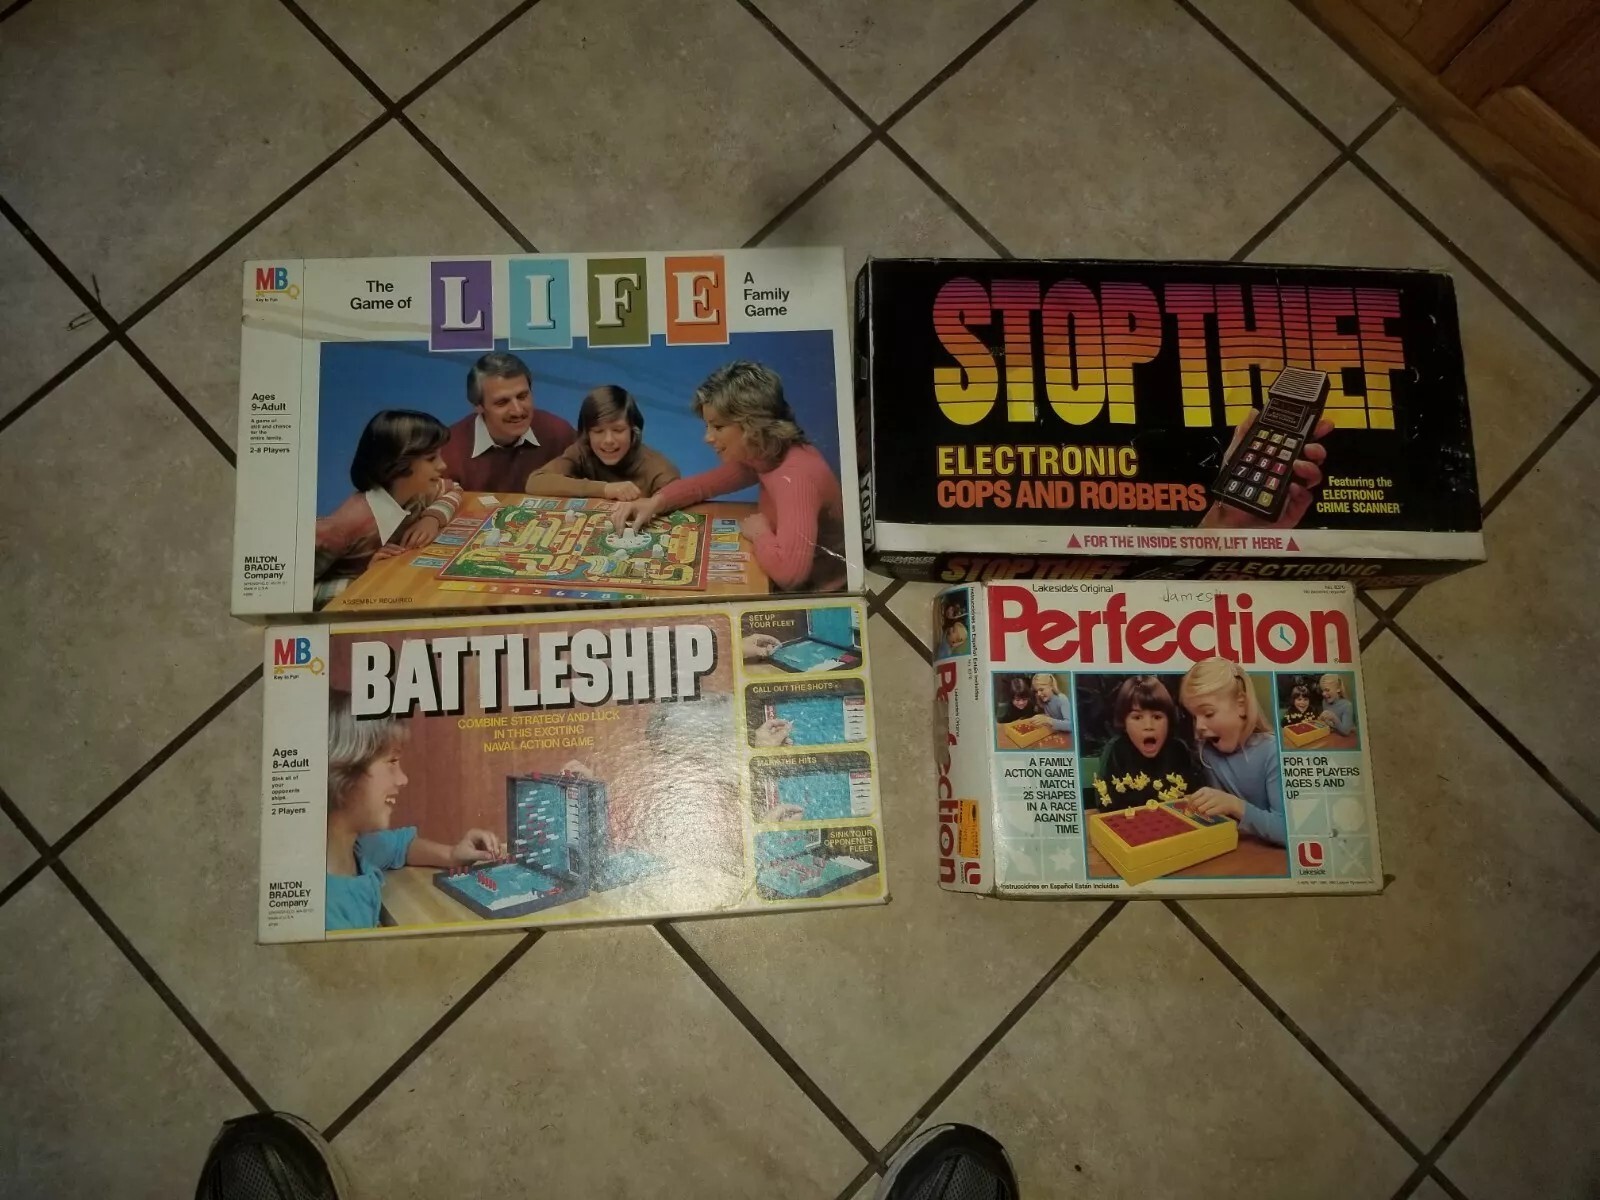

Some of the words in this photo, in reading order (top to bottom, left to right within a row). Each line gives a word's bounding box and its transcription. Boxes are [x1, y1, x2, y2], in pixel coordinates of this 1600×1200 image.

[256, 267, 289, 290] MB
[744, 271, 754, 284] A
[366, 280, 394, 292] The
[744, 287, 790, 302] Family
[350, 297, 394, 310] Game
[397, 296, 412, 309] of
[440, 271, 719, 331] LIFE
[745, 303, 787, 317] Game
[933, 277, 1162, 426] STOP
[1164, 283, 1406, 430] THIEF
[251, 392, 276, 402] Ages
[251, 402, 286, 411] 9-Adult
[263, 447, 290, 455] Players
[937, 445, 1139, 477] ELECTRONIC
[1328, 476, 1374, 488] Featuring
[1376, 477, 1392, 487] the
[937, 480, 1011, 508] COPS
[1016, 481, 1074, 509] AND
[1080, 481, 1206, 512] ROBBERS
[1322, 489, 1384, 500] ELECTRONIC
[1316, 502, 1350, 513] CRIME
[1352, 502, 1400, 514] SCANNER
[1084, 535, 1108, 548] FOR
[1110, 536, 1134, 548] THE
[1137, 536, 1177, 549] INSIDE
[1180, 536, 1221, 551] STORY,
[1224, 537, 1248, 550] LIFT
[1252, 537, 1283, 550] HERE
[244, 556, 278, 564] MILTON
[244, 563, 286, 571] BRADLEY
[1210, 561, 1384, 578] ELECTRONIC
[244, 572, 284, 580] Company
[1032, 584, 1079, 593] Lakeside's
[1080, 584, 1114, 595] Original
[987, 585, 1353, 664] Perfection
[274, 637, 311, 665] MB
[351, 625, 717, 720] BATTLESHIP
[806, 682, 833, 690] SHOTS
[458, 717, 508, 729] COMBINE
[511, 714, 564, 726] STRATEGY
[567, 712, 589, 722] AND
[592, 710, 620, 721] LUCK
[494, 729, 505, 739] IN
[507, 727, 532, 738] THIS
[535, 724, 584, 736] EXCITING
[484, 741, 516, 752] NAVAL
[520, 738, 559, 750] ACTION
[562, 736, 594, 748] GAME
[272, 748, 298, 758] Ages
[272, 759, 309, 768] 8-Adult
[1029, 757, 1037, 766] A
[1040, 757, 1073, 766] FAMILY
[1283, 757, 1304, 766] FOR
[1313, 757, 1328, 765] OR
[1004, 769, 1042, 778] ACTION
[1045, 769, 1075, 778] GAME
[1284, 768, 1313, 777] MORE
[1316, 767, 1360, 777] PLAYERS
[1285, 779, 1312, 788] AGES
[1314, 779, 1321, 787] 5
[1323, 779, 1345, 787] AND
[1023, 791, 1034, 800] 25
[1036, 791, 1076, 800] SHAPES
[1286, 790, 1300, 800] UP
[278, 807, 306, 815] Players
[1026, 802, 1037, 811] IN
[1040, 802, 1048, 811] A
[1050, 802, 1077, 811] RACE
[1034, 813, 1078, 823] AGAINST
[1055, 824, 1079, 834] TIME
[269, 881, 303, 890] MILTON
[1049, 882, 1074, 890] Español
[269, 889, 311, 899] BRADLEY
[269, 899, 309, 908] Company
